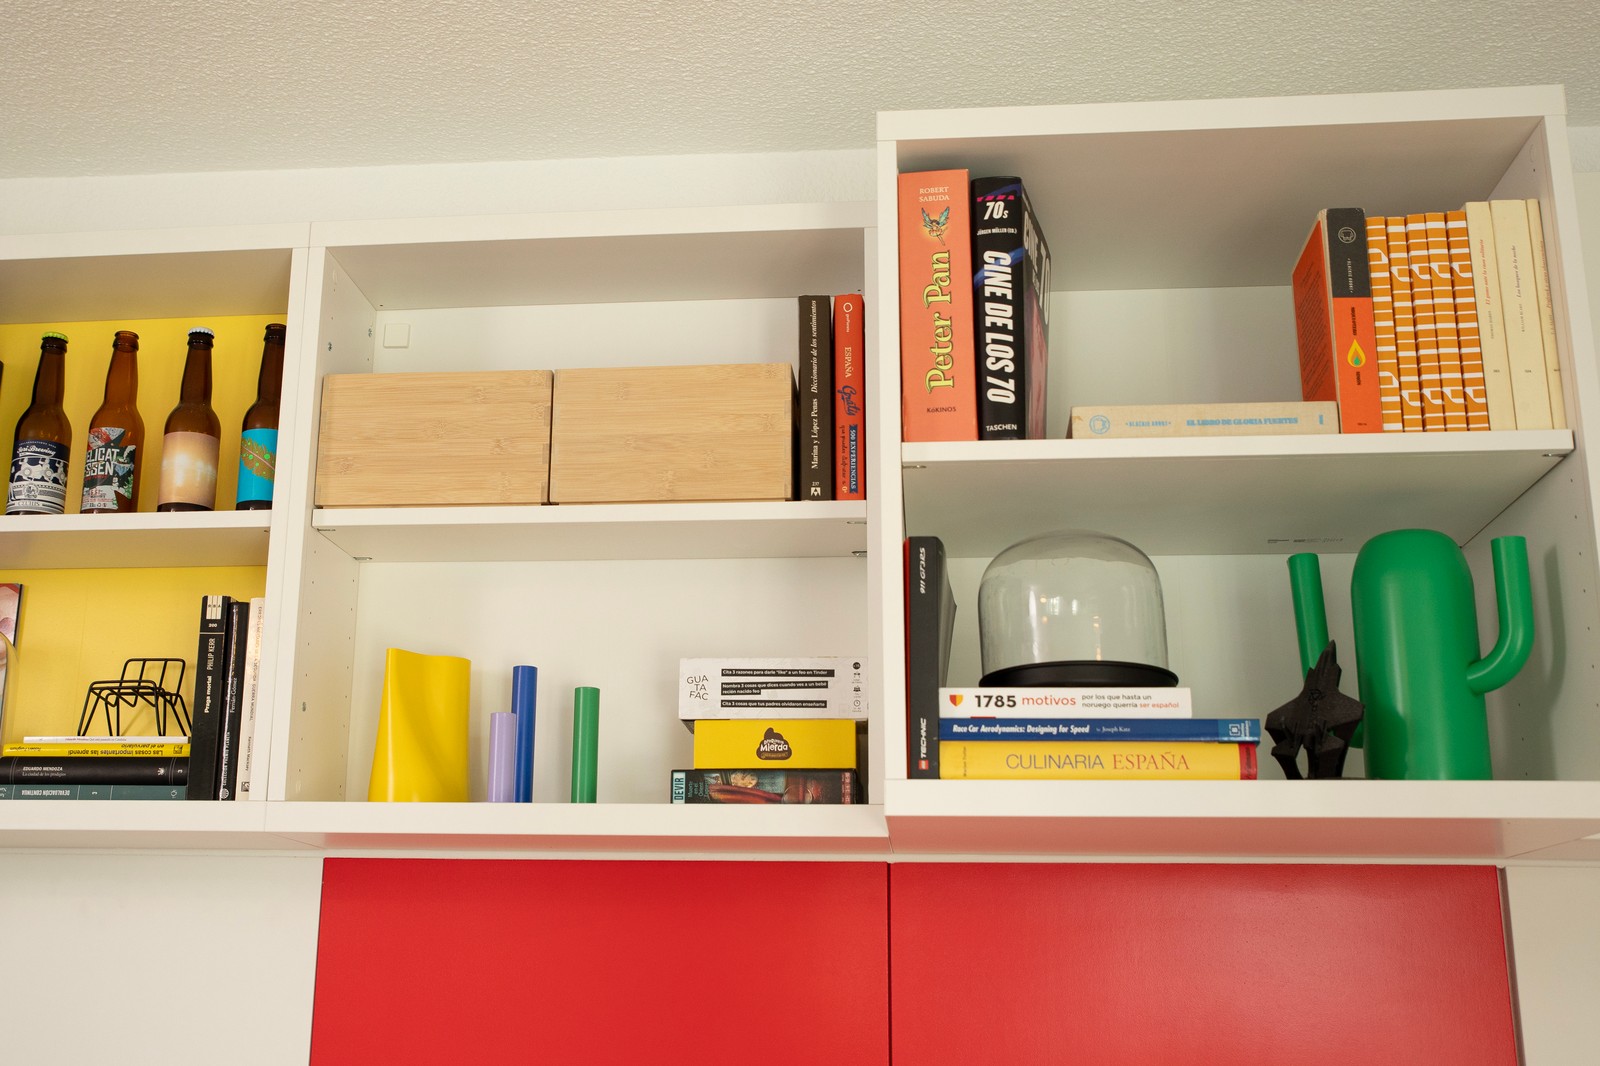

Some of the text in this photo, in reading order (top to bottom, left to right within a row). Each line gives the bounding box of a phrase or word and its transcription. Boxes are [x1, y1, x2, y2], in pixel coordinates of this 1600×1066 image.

[918, 194, 950, 202] SABUDA
[919, 186, 950, 194] ROBERT
[983, 200, 1009, 220] 70s
[809, 300, 817, 337] sentimientos
[923, 249, 955, 394] Peter Pan
[983, 250, 1016, 404] CINE DE LOS 70
[810, 339, 818, 347] los
[811, 348, 818, 356] de
[844, 346, 854, 378] ESPAÑA
[810, 357, 818, 393] Diccionario
[810, 398, 818, 417] Penas
[811, 418, 820, 438] López
[985, 424, 1018, 432] TASCHEN
[1263, 417, 1298, 425] FUERTES
[810, 445, 819, 469] Marina
[206, 637, 216, 671] PHILIP KERR
[686, 674, 709, 684] GUA
[693, 683, 707, 691] TA
[689, 690, 709, 701] FAC
[974, 694, 1077, 708] 1785 motivos
[203, 696, 212, 714] Praga
[953, 725, 968, 733] Race
[968, 725, 979, 733] Car
[980, 725, 1025, 734] Aerodynamics:
[1026, 725, 1057, 735] Designing
[1058, 725, 1068, 733] for
[1069, 724, 1090, 734] Speed
[760, 743, 788, 752] Mierda
[1005, 751, 1190, 770] CULINARIA ESPAÑA
[42, 789, 70, 797] DEVALUACIÓN
[673, 777, 684, 801] DEVIR
